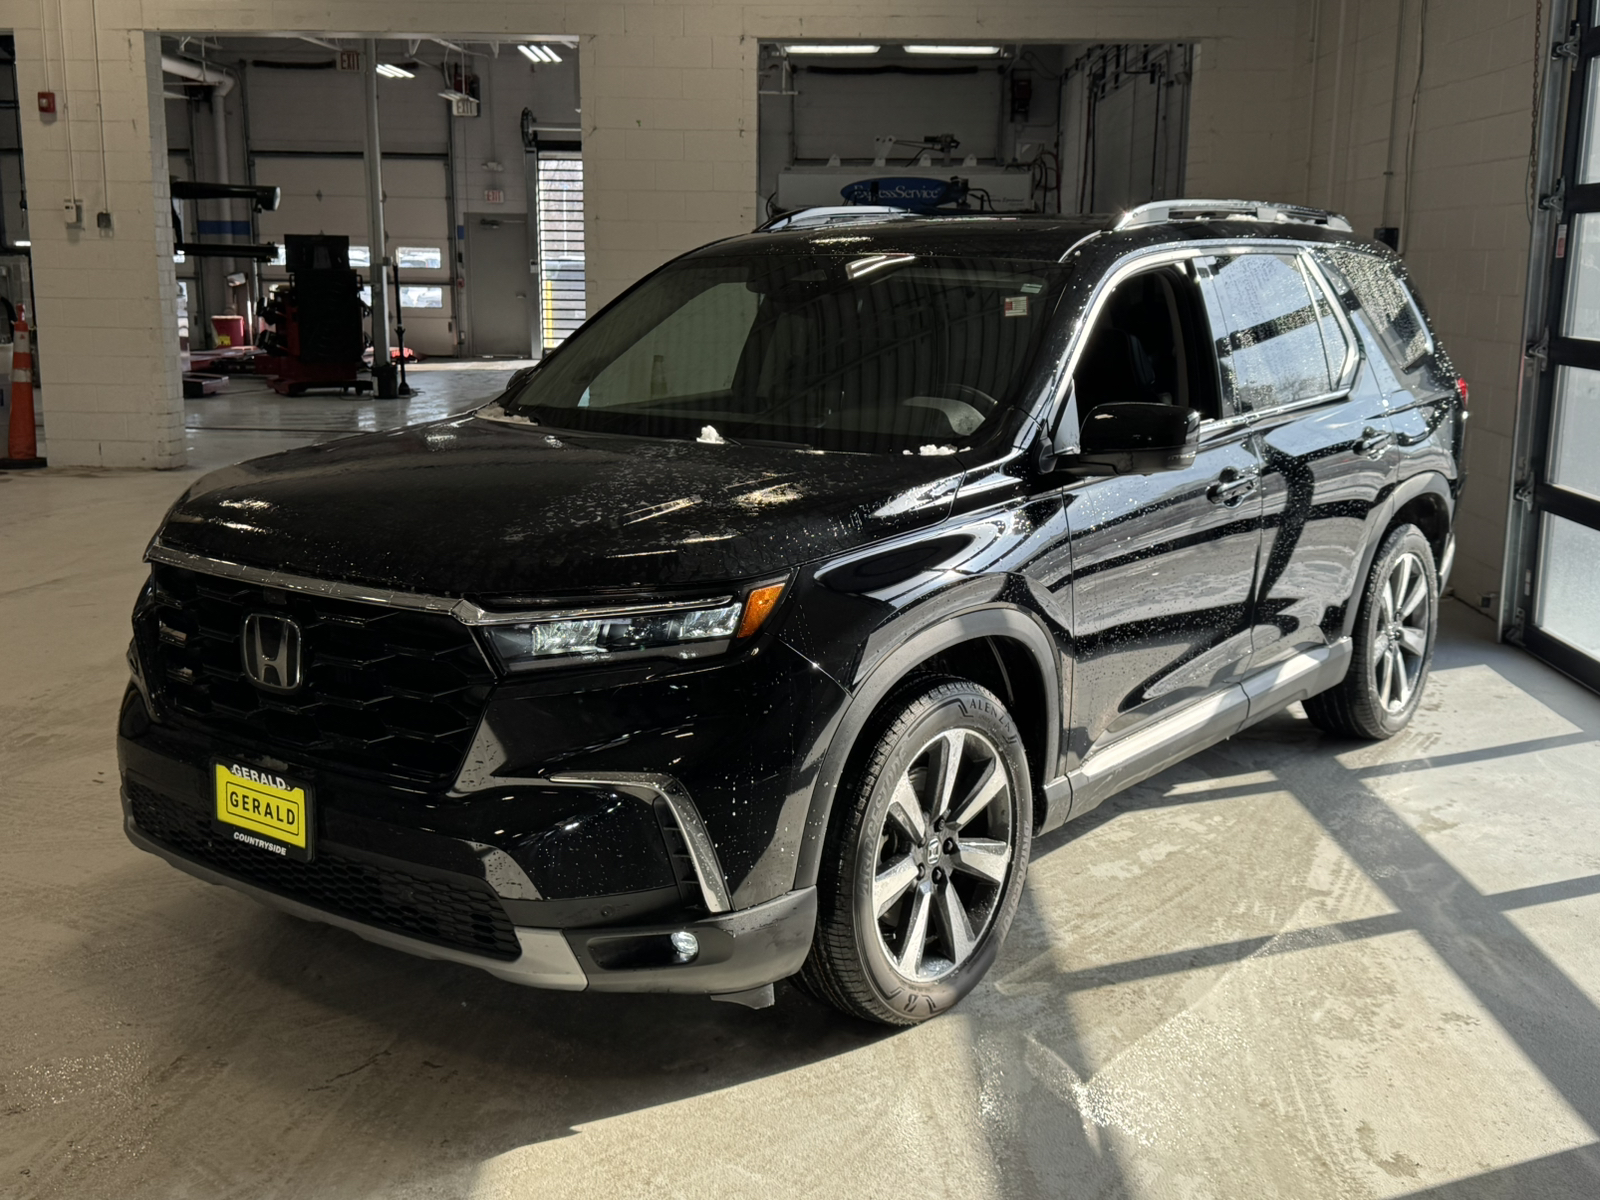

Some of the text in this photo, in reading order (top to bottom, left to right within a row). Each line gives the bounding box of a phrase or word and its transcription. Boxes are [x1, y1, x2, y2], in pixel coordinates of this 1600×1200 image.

[340, 52, 360, 71] EXIT
[456, 100, 473, 115] EXIT
[231, 764, 287, 790] GERALD
[230, 791, 296, 825] GERALD
[233, 831, 287, 856] COUNTRYSIDE
